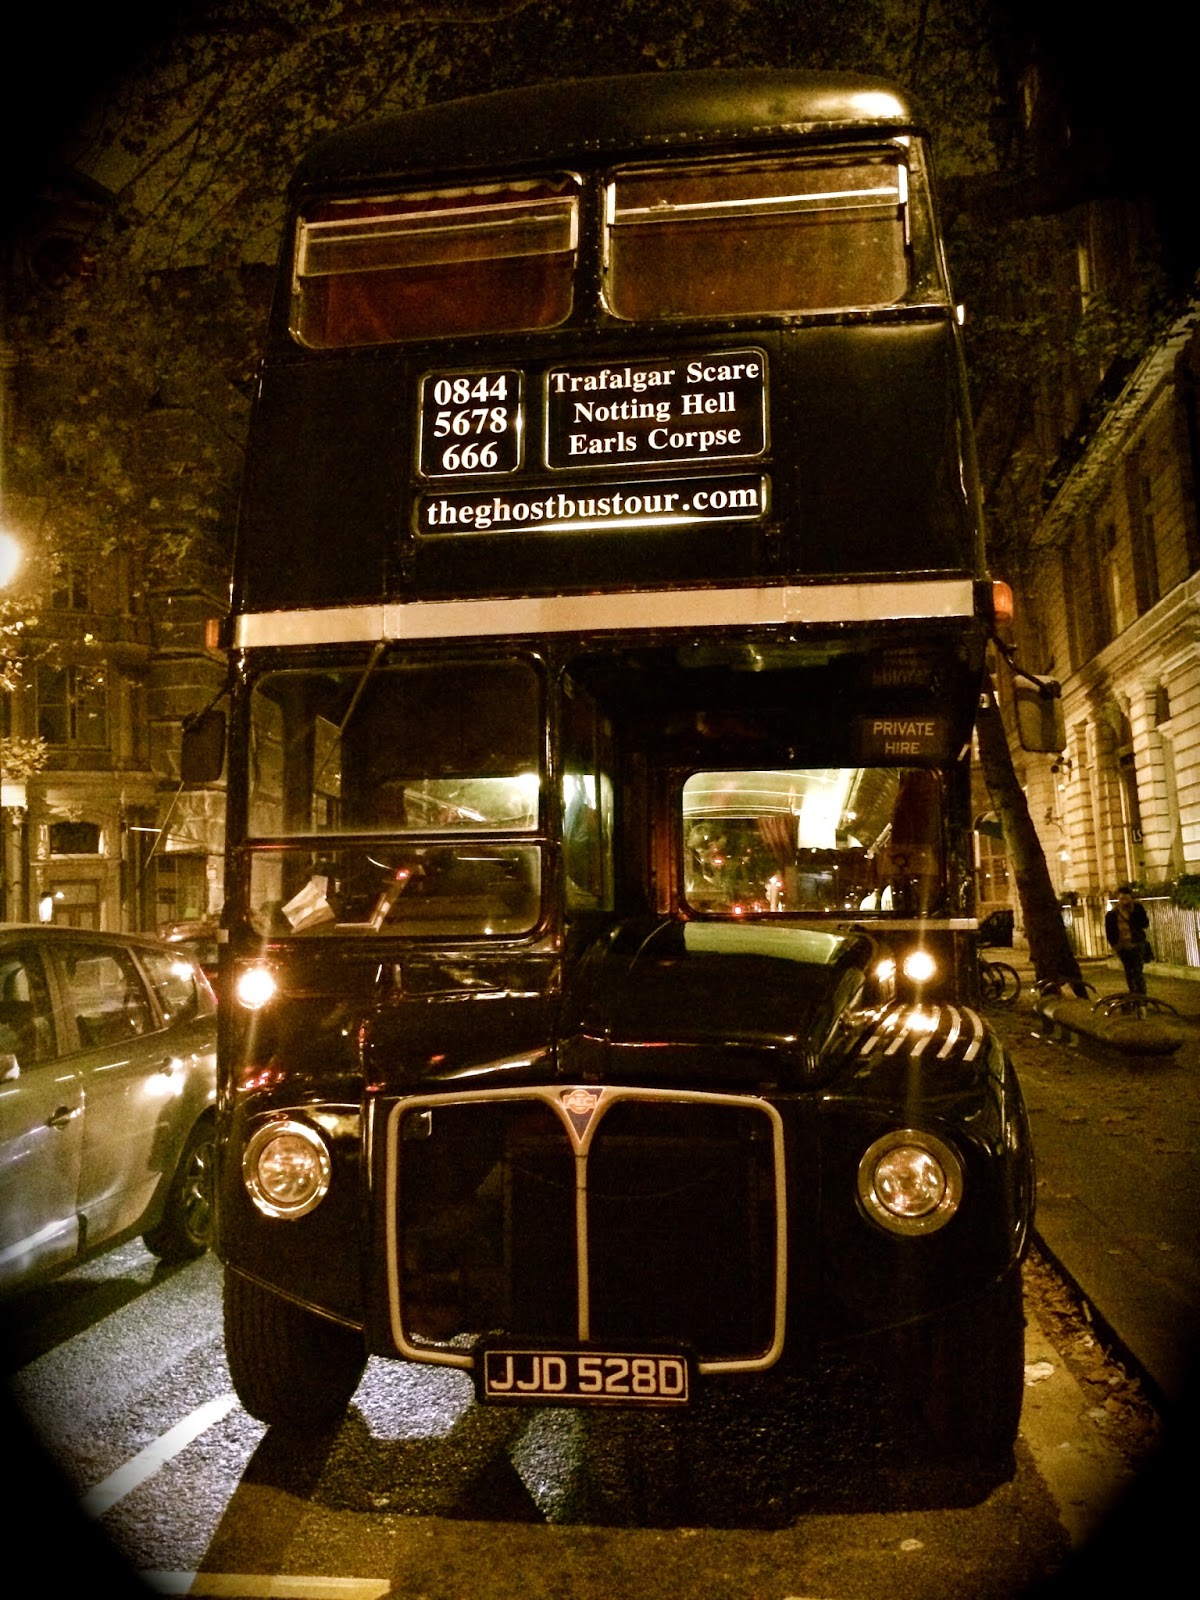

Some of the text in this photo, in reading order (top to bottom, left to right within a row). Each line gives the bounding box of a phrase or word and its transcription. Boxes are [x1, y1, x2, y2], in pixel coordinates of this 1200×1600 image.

[434, 375, 507, 406] 0844
[552, 362, 759, 393] Trafalgar Scare
[433, 407, 507, 437] 5678
[573, 391, 736, 424] Notting Hell
[442, 441, 498, 470] 666
[568, 428, 742, 456] Earls Corpse
[426, 488, 758, 529] theghostbustour.com
[873, 721, 935, 736] PRIVATE
[885, 742, 920, 755] HIRE
[566, 1096, 594, 1107] AEC
[490, 1356, 684, 1395] JJD 528D
